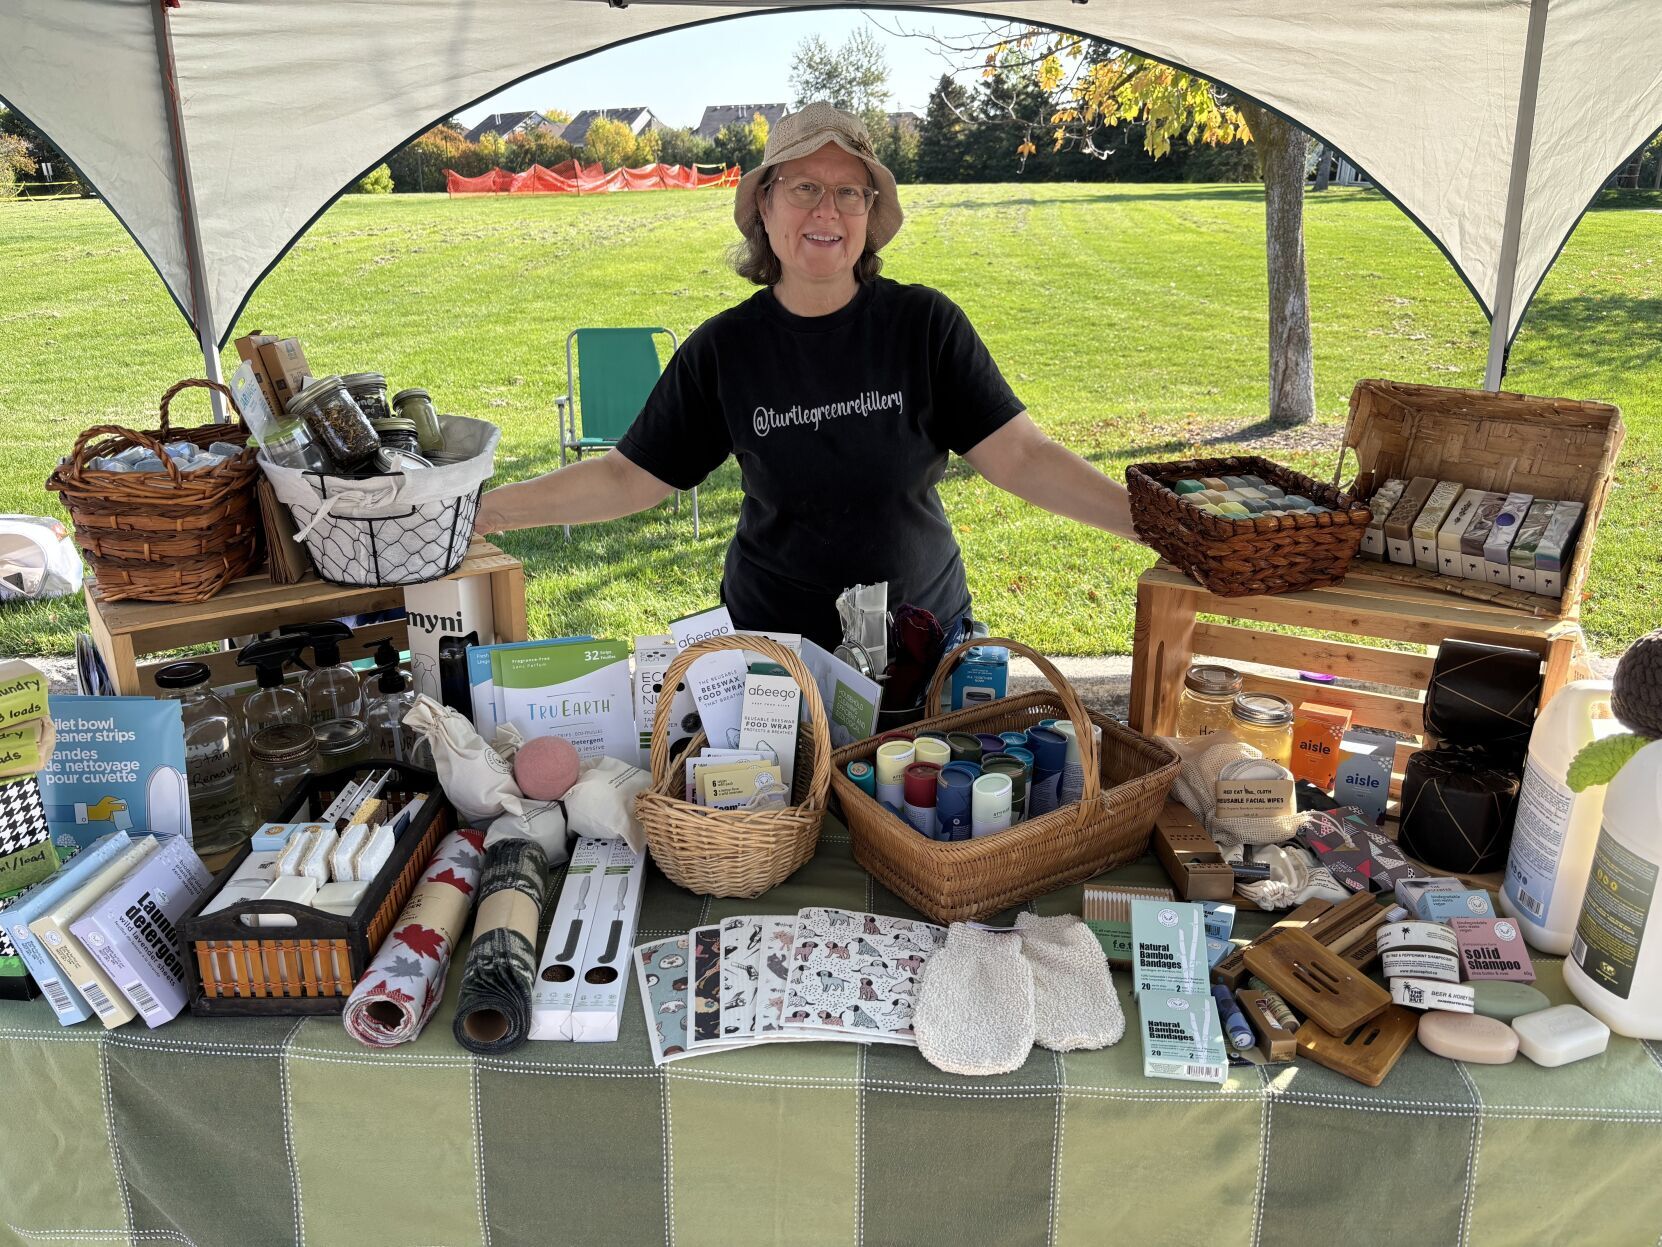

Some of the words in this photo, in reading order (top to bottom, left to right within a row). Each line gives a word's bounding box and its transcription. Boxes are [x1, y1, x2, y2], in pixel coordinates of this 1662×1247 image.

[753, 390, 903, 437] @turtlegreenrefillery
[407, 611, 463, 633] myni
[584, 650, 600, 662] 32
[701, 676, 740, 693] BEESWAX
[698, 690, 722, 702] FOOD
[719, 691, 744, 703] BREATHE
[748, 684, 796, 701] abeego
[10, 702, 41, 719] loads
[54, 718, 76, 730] ilet
[78, 717, 114, 730] bowl
[770, 722, 793, 730] WRAP
[55, 731, 92, 742] eaner
[95, 729, 136, 743] strips
[571, 737, 604, 747] Detergent
[1299, 740, 1331, 755] aisle
[190, 750, 230, 769] Stain
[45, 759, 61, 771] de
[65, 760, 140, 774] nettoyage
[46, 773, 78, 786] pour
[82, 770, 137, 783] cuvette
[192, 762, 241, 788] Remover
[1346, 773, 1380, 788] aisle
[713, 789, 718, 797] 3
[137, 891, 181, 957] Laund
[119, 914, 133, 931] wild
[132, 929, 159, 963] lavender
[156, 962, 177, 987] sheets
[1139, 942, 1170, 952] Natural
[1464, 947, 1501, 960] solid
[1139, 951, 1174, 961] Bamboo
[1140, 959, 1182, 970] Bandages
[1467, 959, 1522, 972] shampoo
[1141, 982, 1151, 991] 20
[1176, 984, 1181, 993] 2
[1148, 1020, 1180, 1029] Natural
[1149, 1033, 1194, 1041] Bandages
